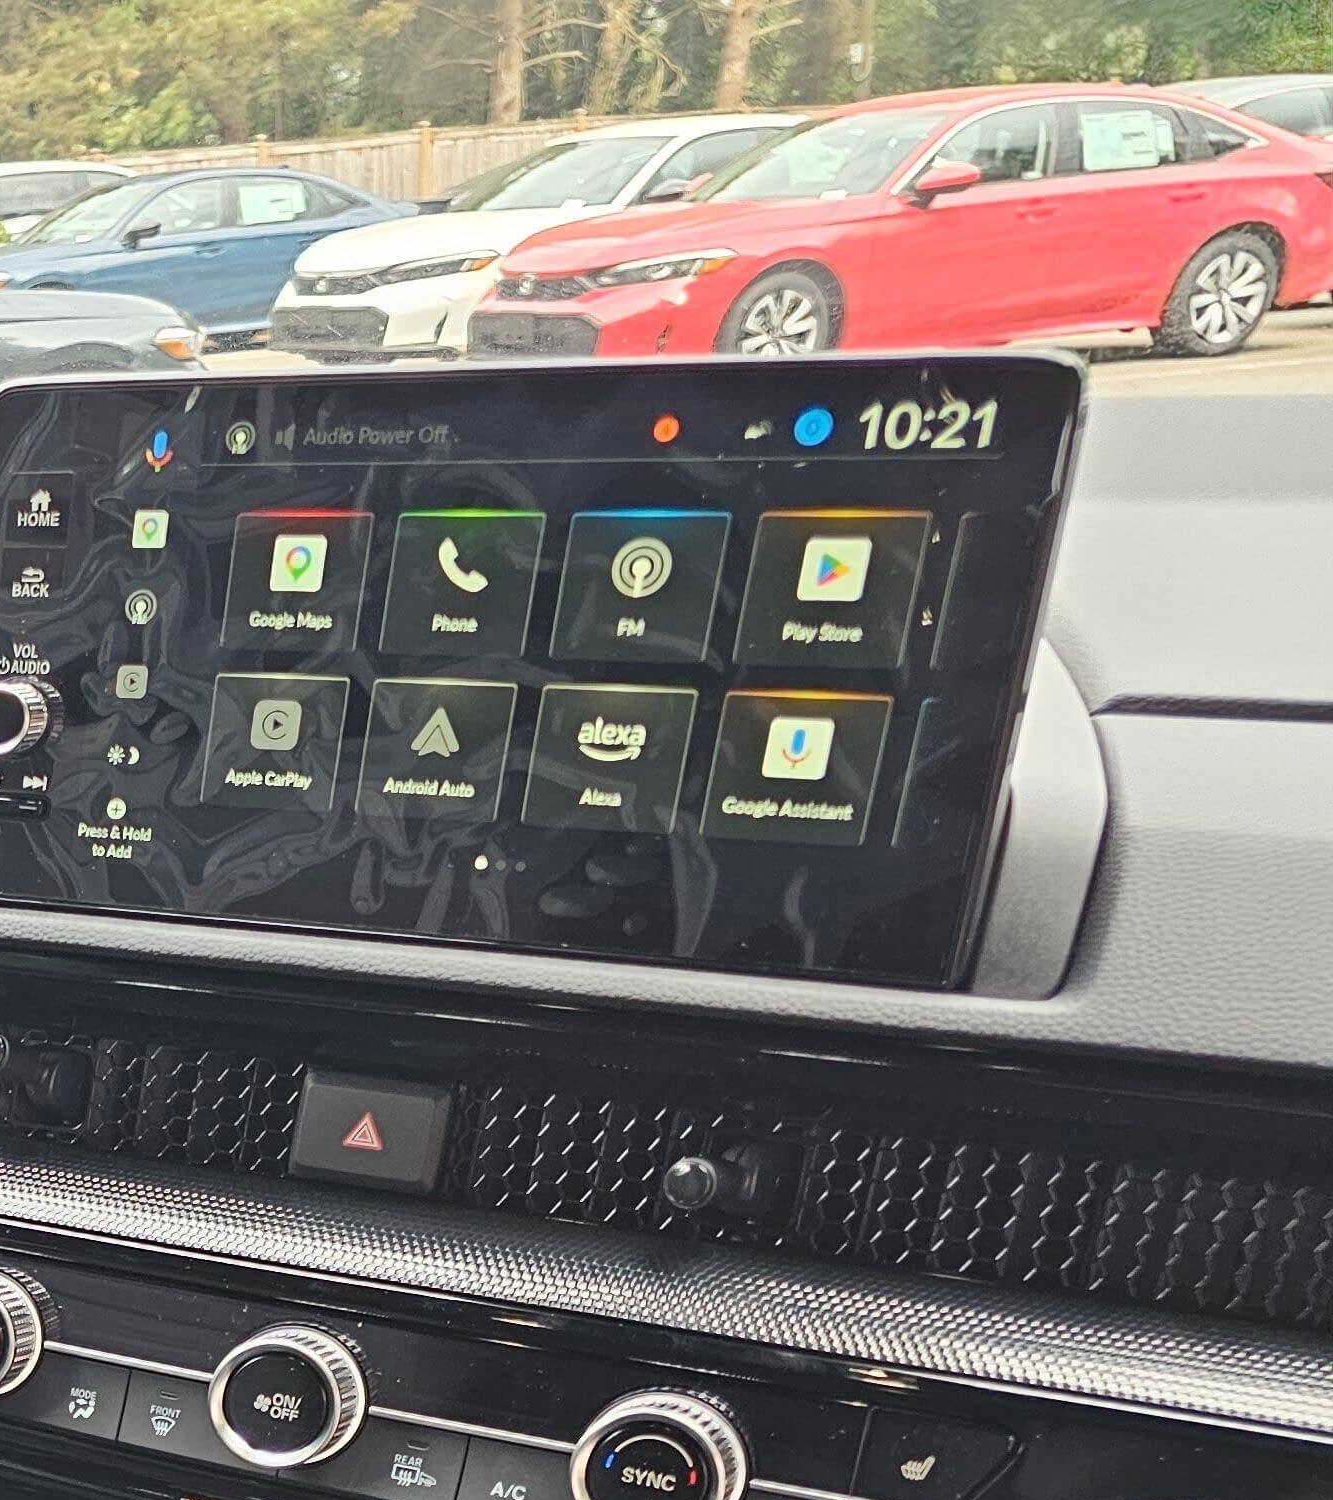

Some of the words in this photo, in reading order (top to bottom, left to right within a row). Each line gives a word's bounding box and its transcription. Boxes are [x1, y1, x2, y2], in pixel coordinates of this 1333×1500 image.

[859, 400, 998, 450] 10:21
[303, 427, 354, 446] Audio
[359, 426, 414, 445] Power
[418, 424, 449, 444] Off
[17, 512, 61, 527] HOME
[12, 582, 50, 598] BACK
[249, 610, 296, 630] Google
[296, 611, 333, 632] Maps
[432, 613, 479, 633] Phone
[617, 617, 646, 637] FM
[782, 620, 817, 645] Play
[818, 622, 864, 643] Store
[13, 643, 39, 659] VOL
[11, 660, 51, 675] AUDIO
[577, 716, 647, 747] alexa
[224, 768, 263, 788] Apple
[264, 770, 313, 791] CarPlay
[383, 776, 438, 796] Android
[438, 779, 476, 798] Auto
[579, 788, 622, 807] Alexa
[722, 796, 779, 819] Google
[778, 799, 854, 821] Assistant
[77, 822, 109, 839] Press
[109, 825, 121, 840] &
[122, 826, 152, 841] Hold
[92, 844, 106, 857] to
[106, 844, 133, 859] Add
[69, 1387, 98, 1401] MODE
[272, 1392, 302, 1410] ON/
[149, 1404, 182, 1419] FRONT
[269, 1406, 300, 1422] OFF
[393, 1453, 423, 1468] REAR
[620, 1466, 677, 1492] SYNC
